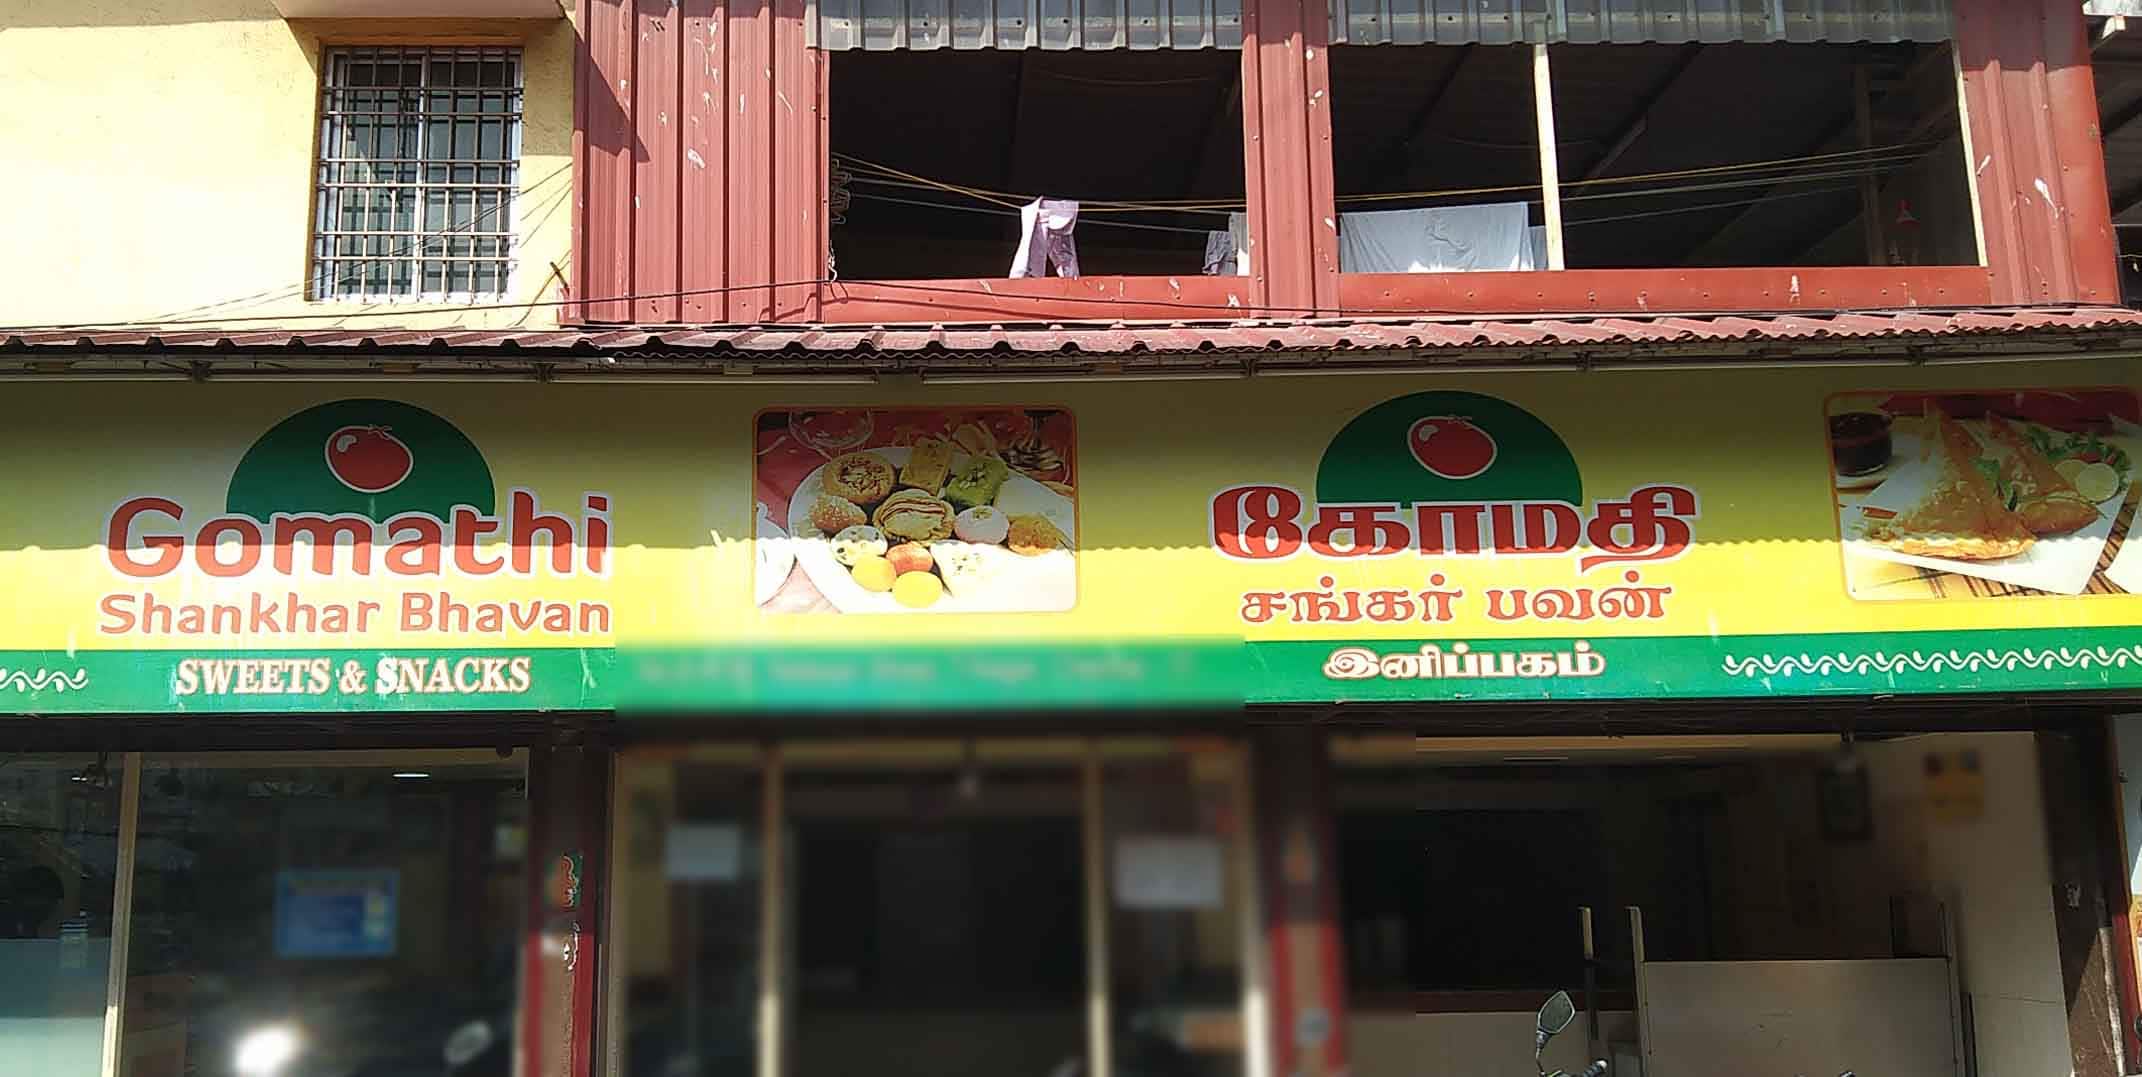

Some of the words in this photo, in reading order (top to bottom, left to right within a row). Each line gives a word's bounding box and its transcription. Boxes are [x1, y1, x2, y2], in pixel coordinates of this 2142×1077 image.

[105, 490, 609, 577] Gomathi
[1213, 485, 1696, 572] கோமதி
[100, 592, 380, 634] Shankhar
[400, 592, 609, 632] Bhavan
[1240, 573, 1463, 622] சங்கர்
[1486, 570, 1672, 619] பவன்
[176, 658, 331, 695] SWEETS
[340, 662, 366, 693] &
[375, 656, 531, 694] SNACKS
[1322, 640, 1606, 680] இனிப்பகம்
